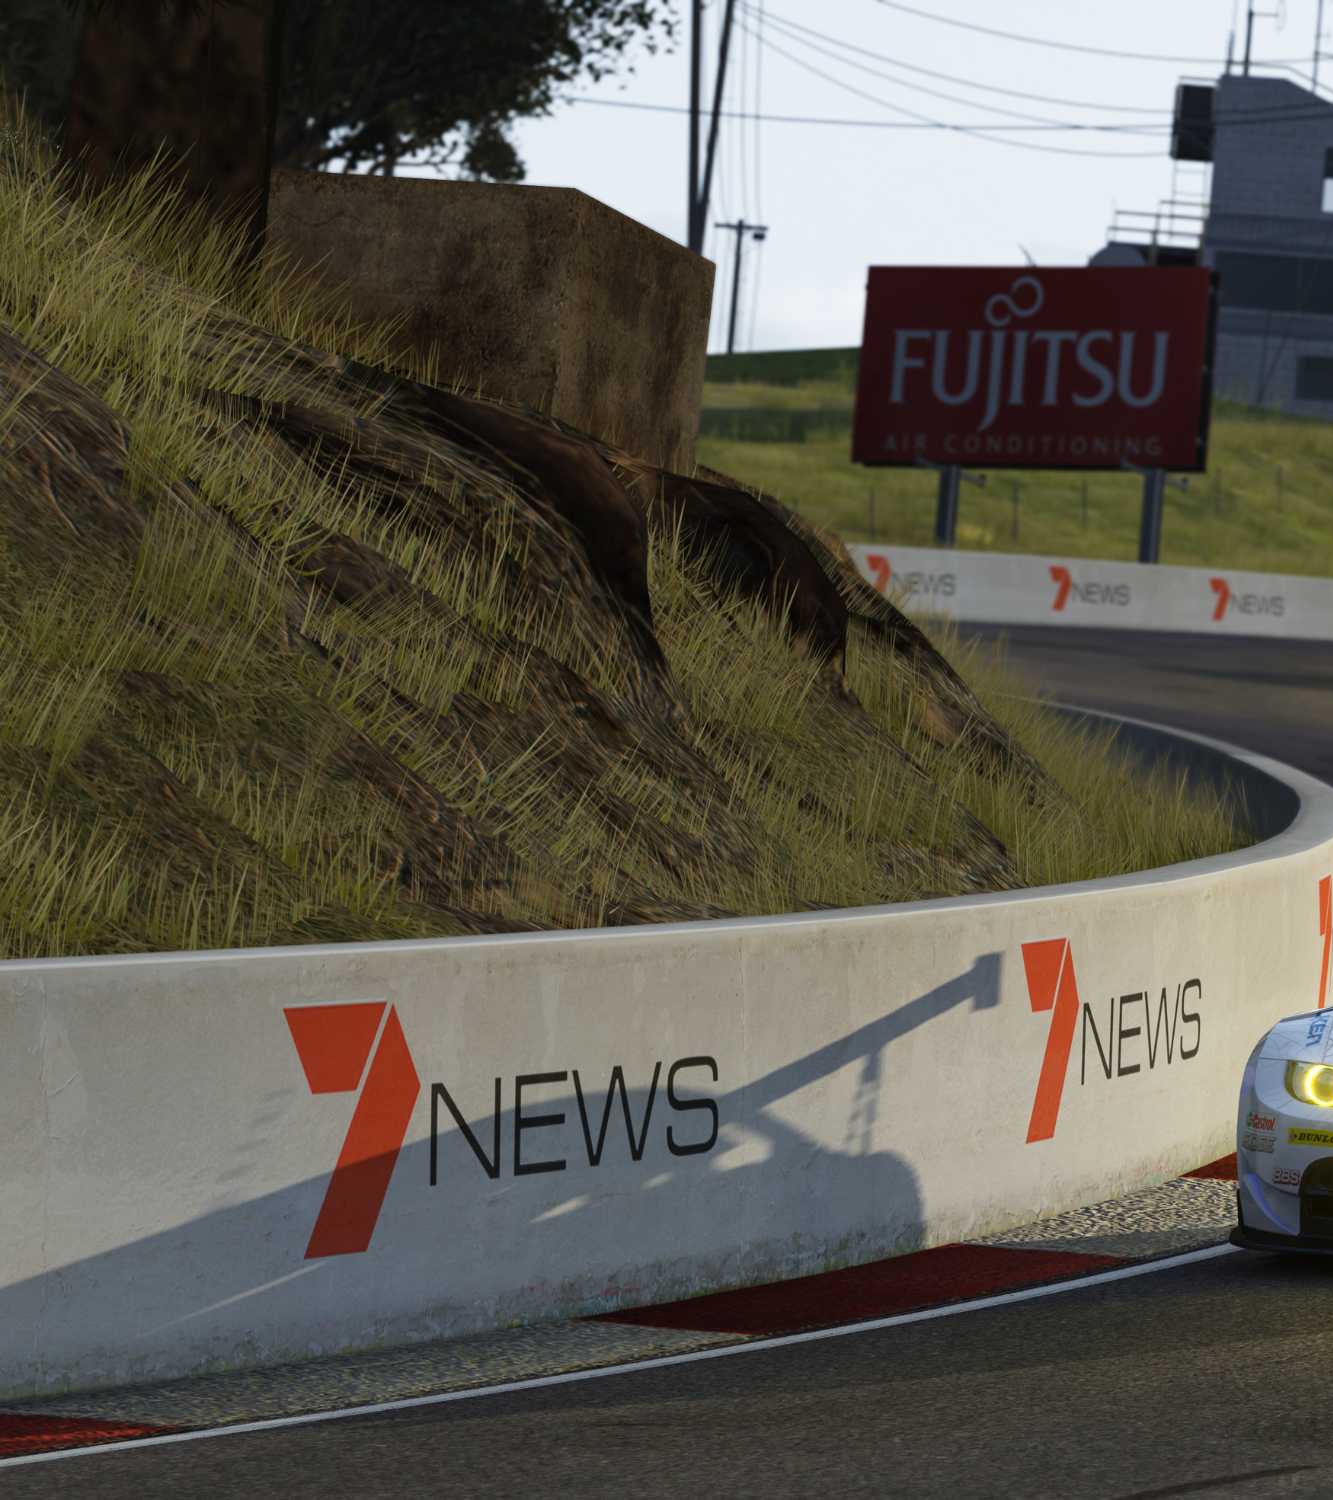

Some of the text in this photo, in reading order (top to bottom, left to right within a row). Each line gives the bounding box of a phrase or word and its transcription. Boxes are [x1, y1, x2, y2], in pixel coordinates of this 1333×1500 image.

[890, 330, 1170, 431] FUJITSU
[884, 433, 1163, 457] AIR CONDITIONING
[892, 571, 957, 597] NEWS
[1073, 583, 1132, 607] NEWS
[1232, 594, 1285, 617] NEWS
[1021, 937, 1202, 1144] 7 NEWS
[283, 1002, 719, 1259] 7 NEWS
